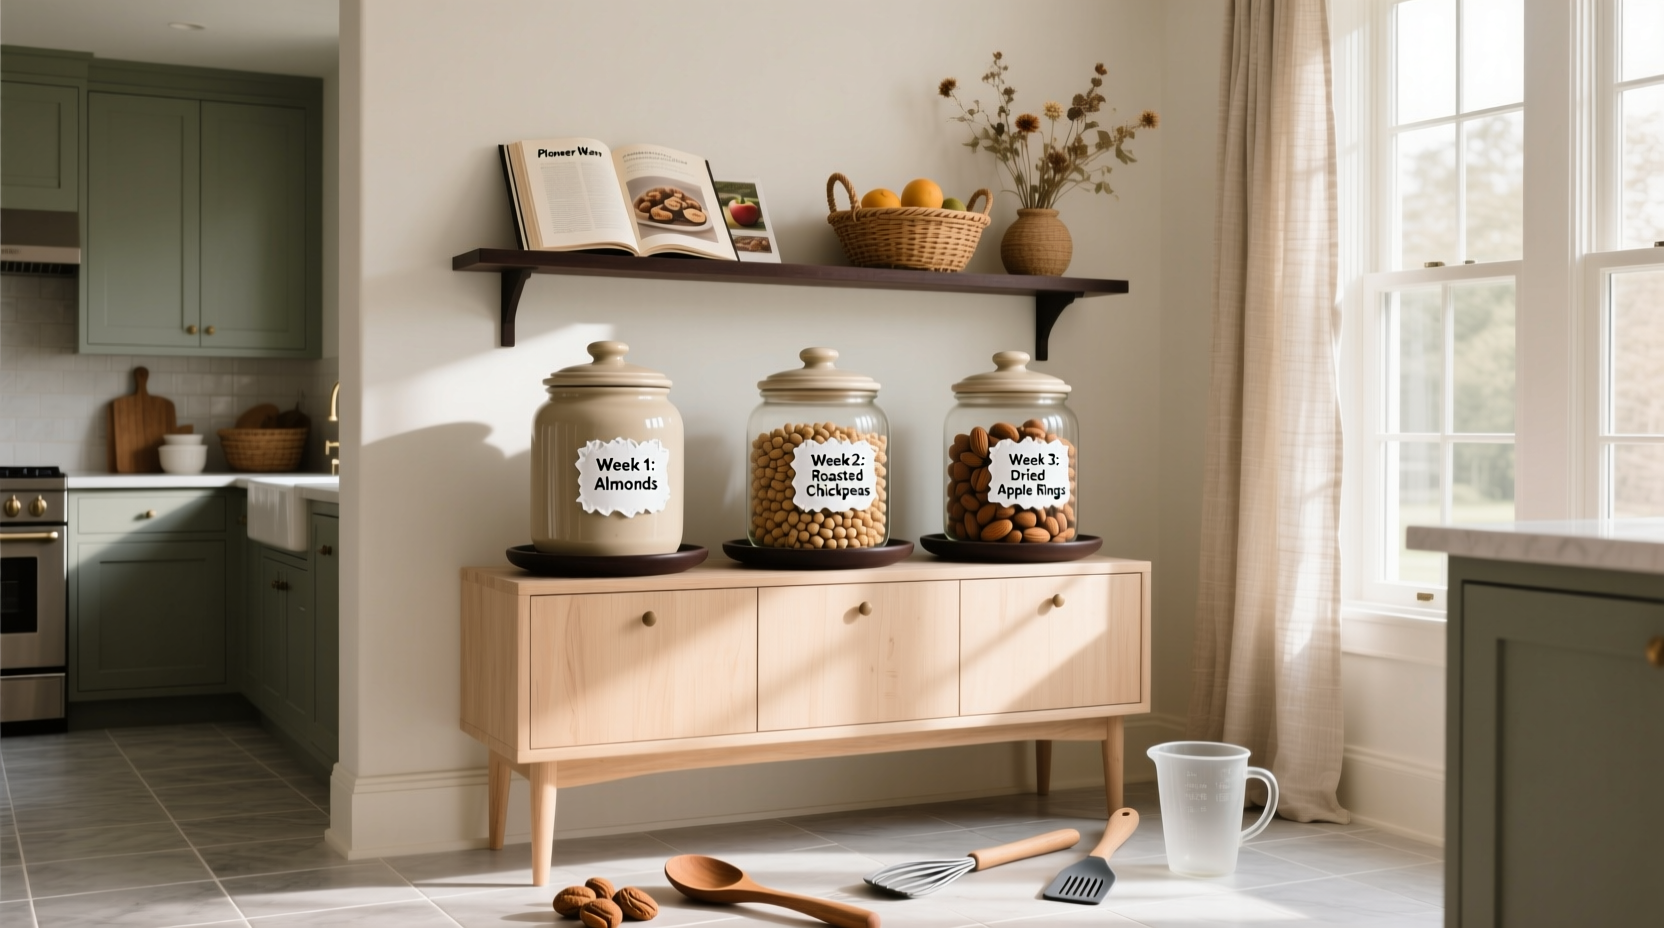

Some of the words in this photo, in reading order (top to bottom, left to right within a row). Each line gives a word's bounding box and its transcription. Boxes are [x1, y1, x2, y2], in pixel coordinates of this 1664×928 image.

[596, 457, 640, 471] Week
[643, 458, 655, 471] 1:
[810, 453, 850, 467] Week
[851, 453, 865, 467] 2:
[1008, 453, 1045, 466] Week
[811, 469, 864, 482] Roasted
[1010, 468, 1046, 481] Dried
[594, 476, 658, 491] Almonds
[806, 484, 871, 500] Chickpeas
[997, 484, 1033, 500] Apple
